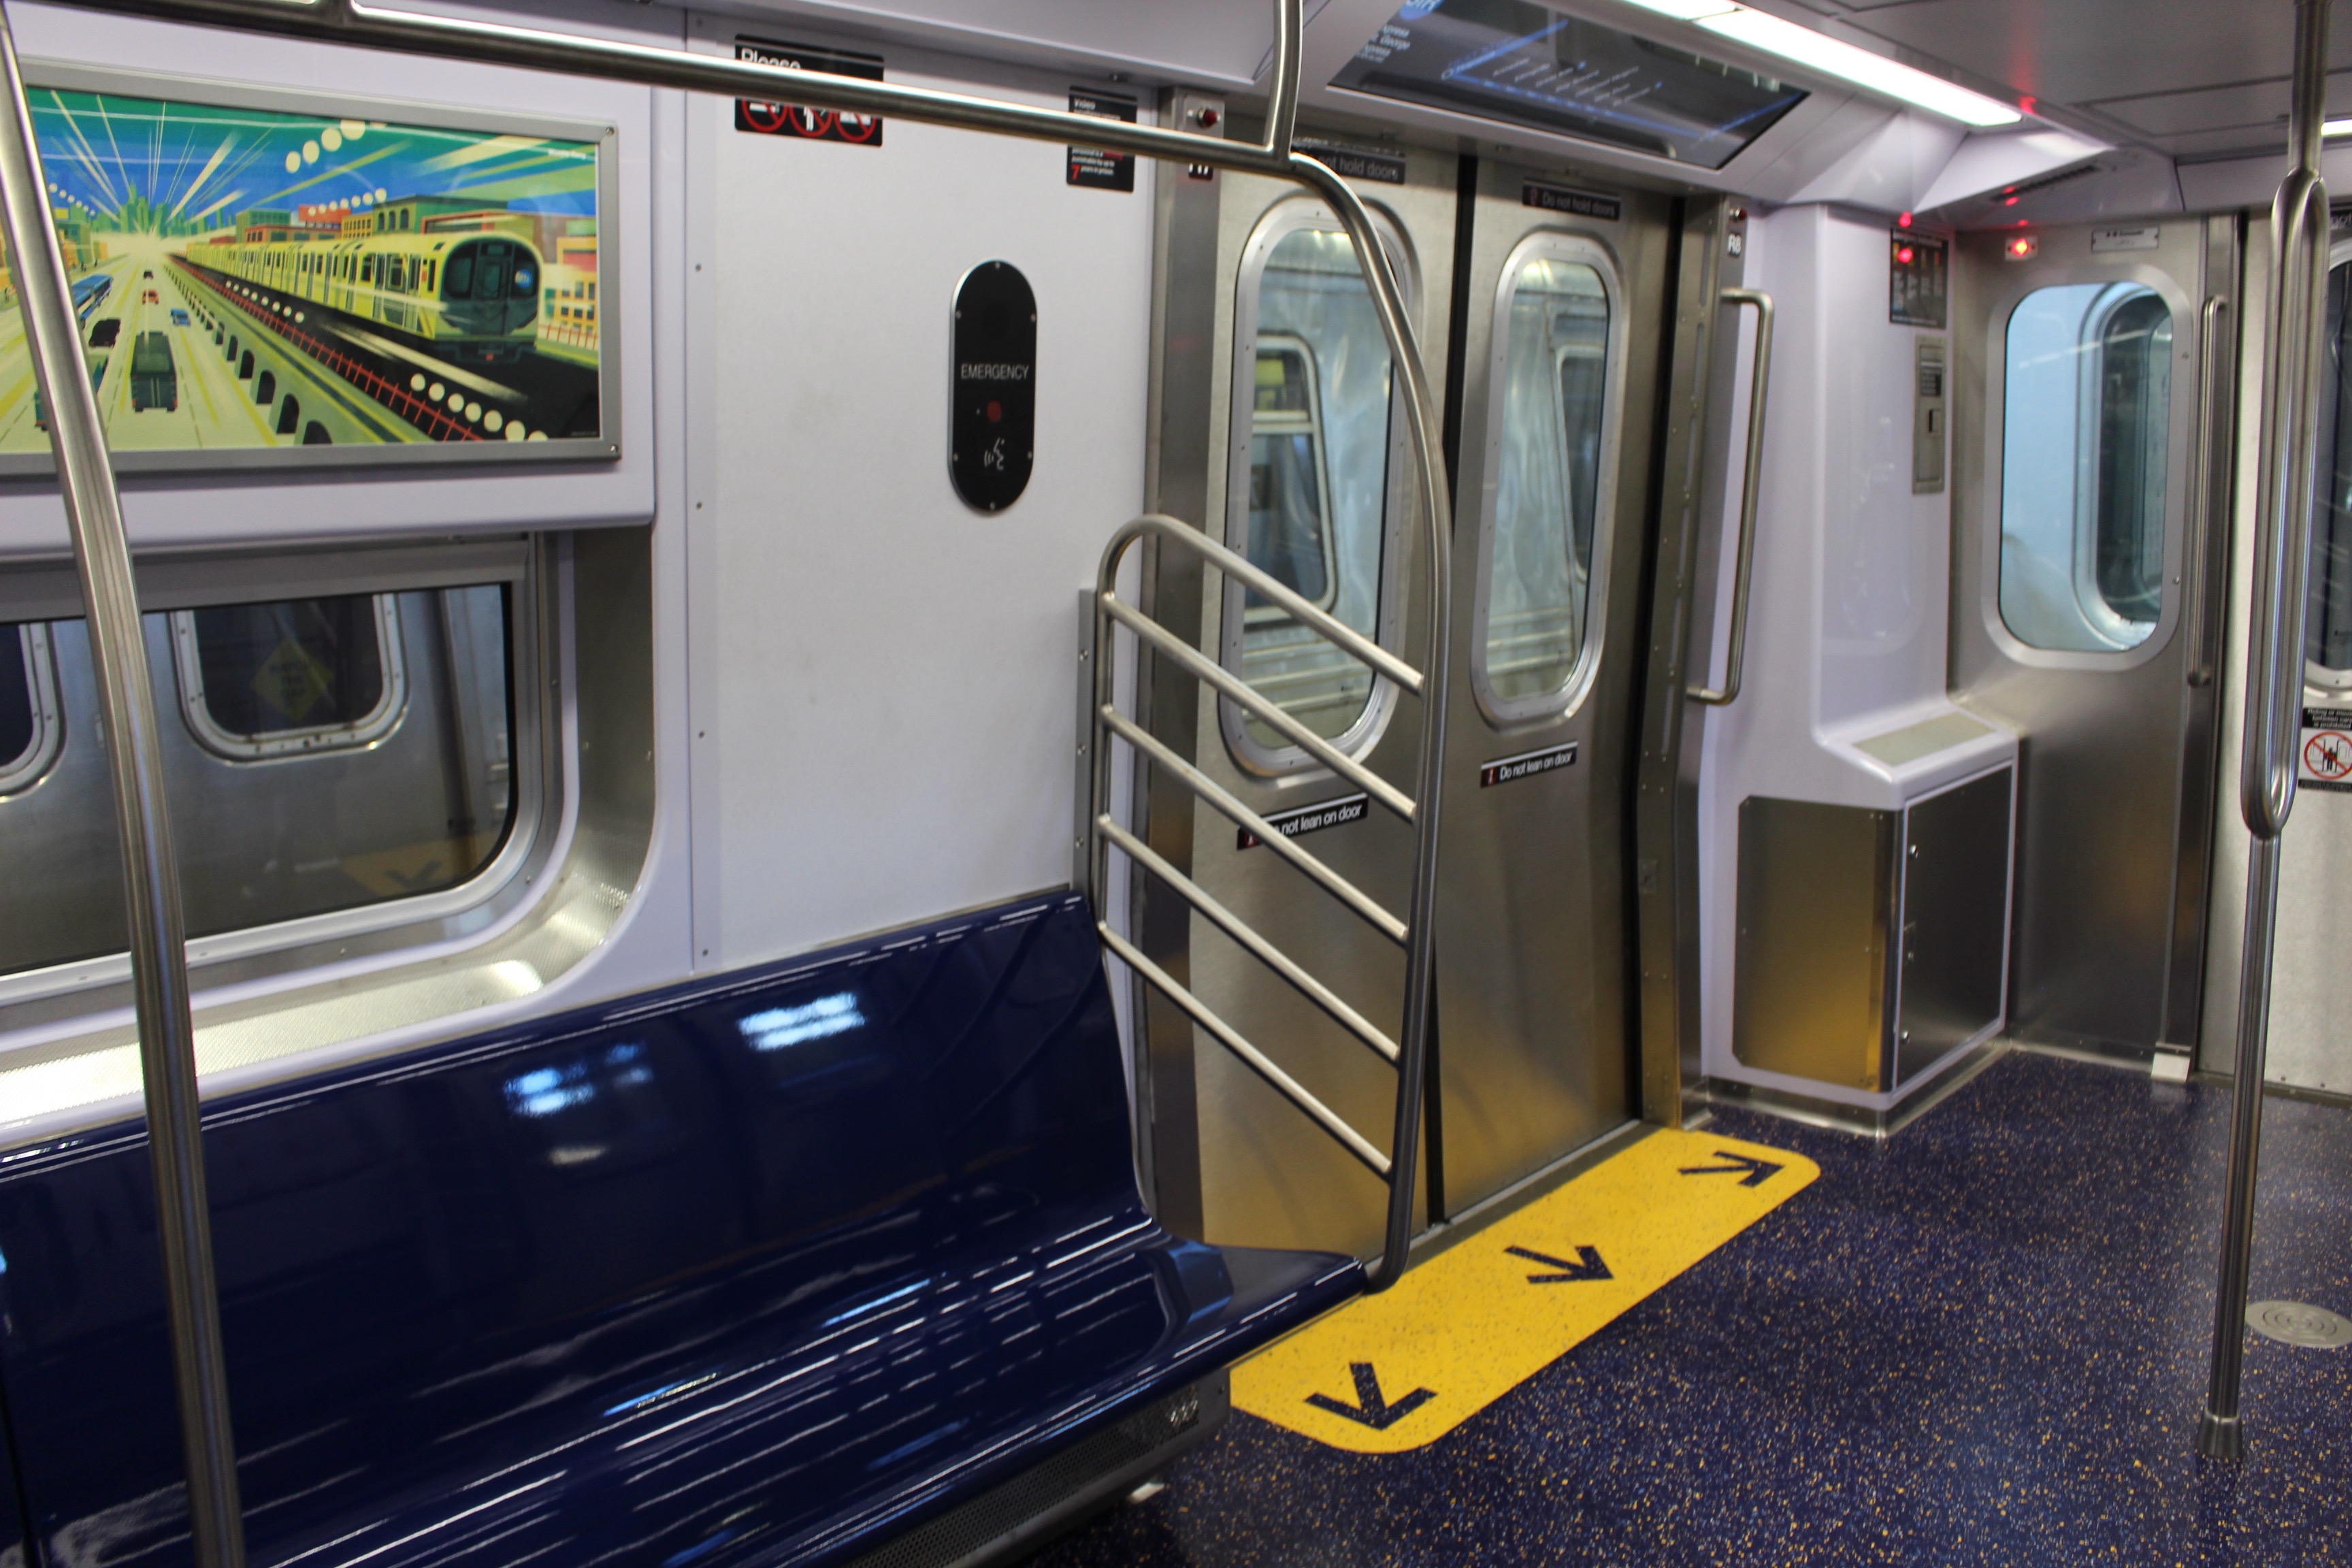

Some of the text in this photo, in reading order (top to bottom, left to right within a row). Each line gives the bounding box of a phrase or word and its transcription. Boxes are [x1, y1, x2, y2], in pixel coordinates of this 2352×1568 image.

[1071, 164, 1080, 180] 7
[1339, 157, 1365, 176] hold
[1367, 163, 1399, 180] doors
[961, 363, 1029, 380] EMERGENCY
[1499, 751, 1573, 781] Do not lean on door
[1281, 818, 1298, 835] not
[1301, 815, 1322, 831] lean
[1324, 812, 1337, 825] on
[1338, 804, 1362, 822] door
